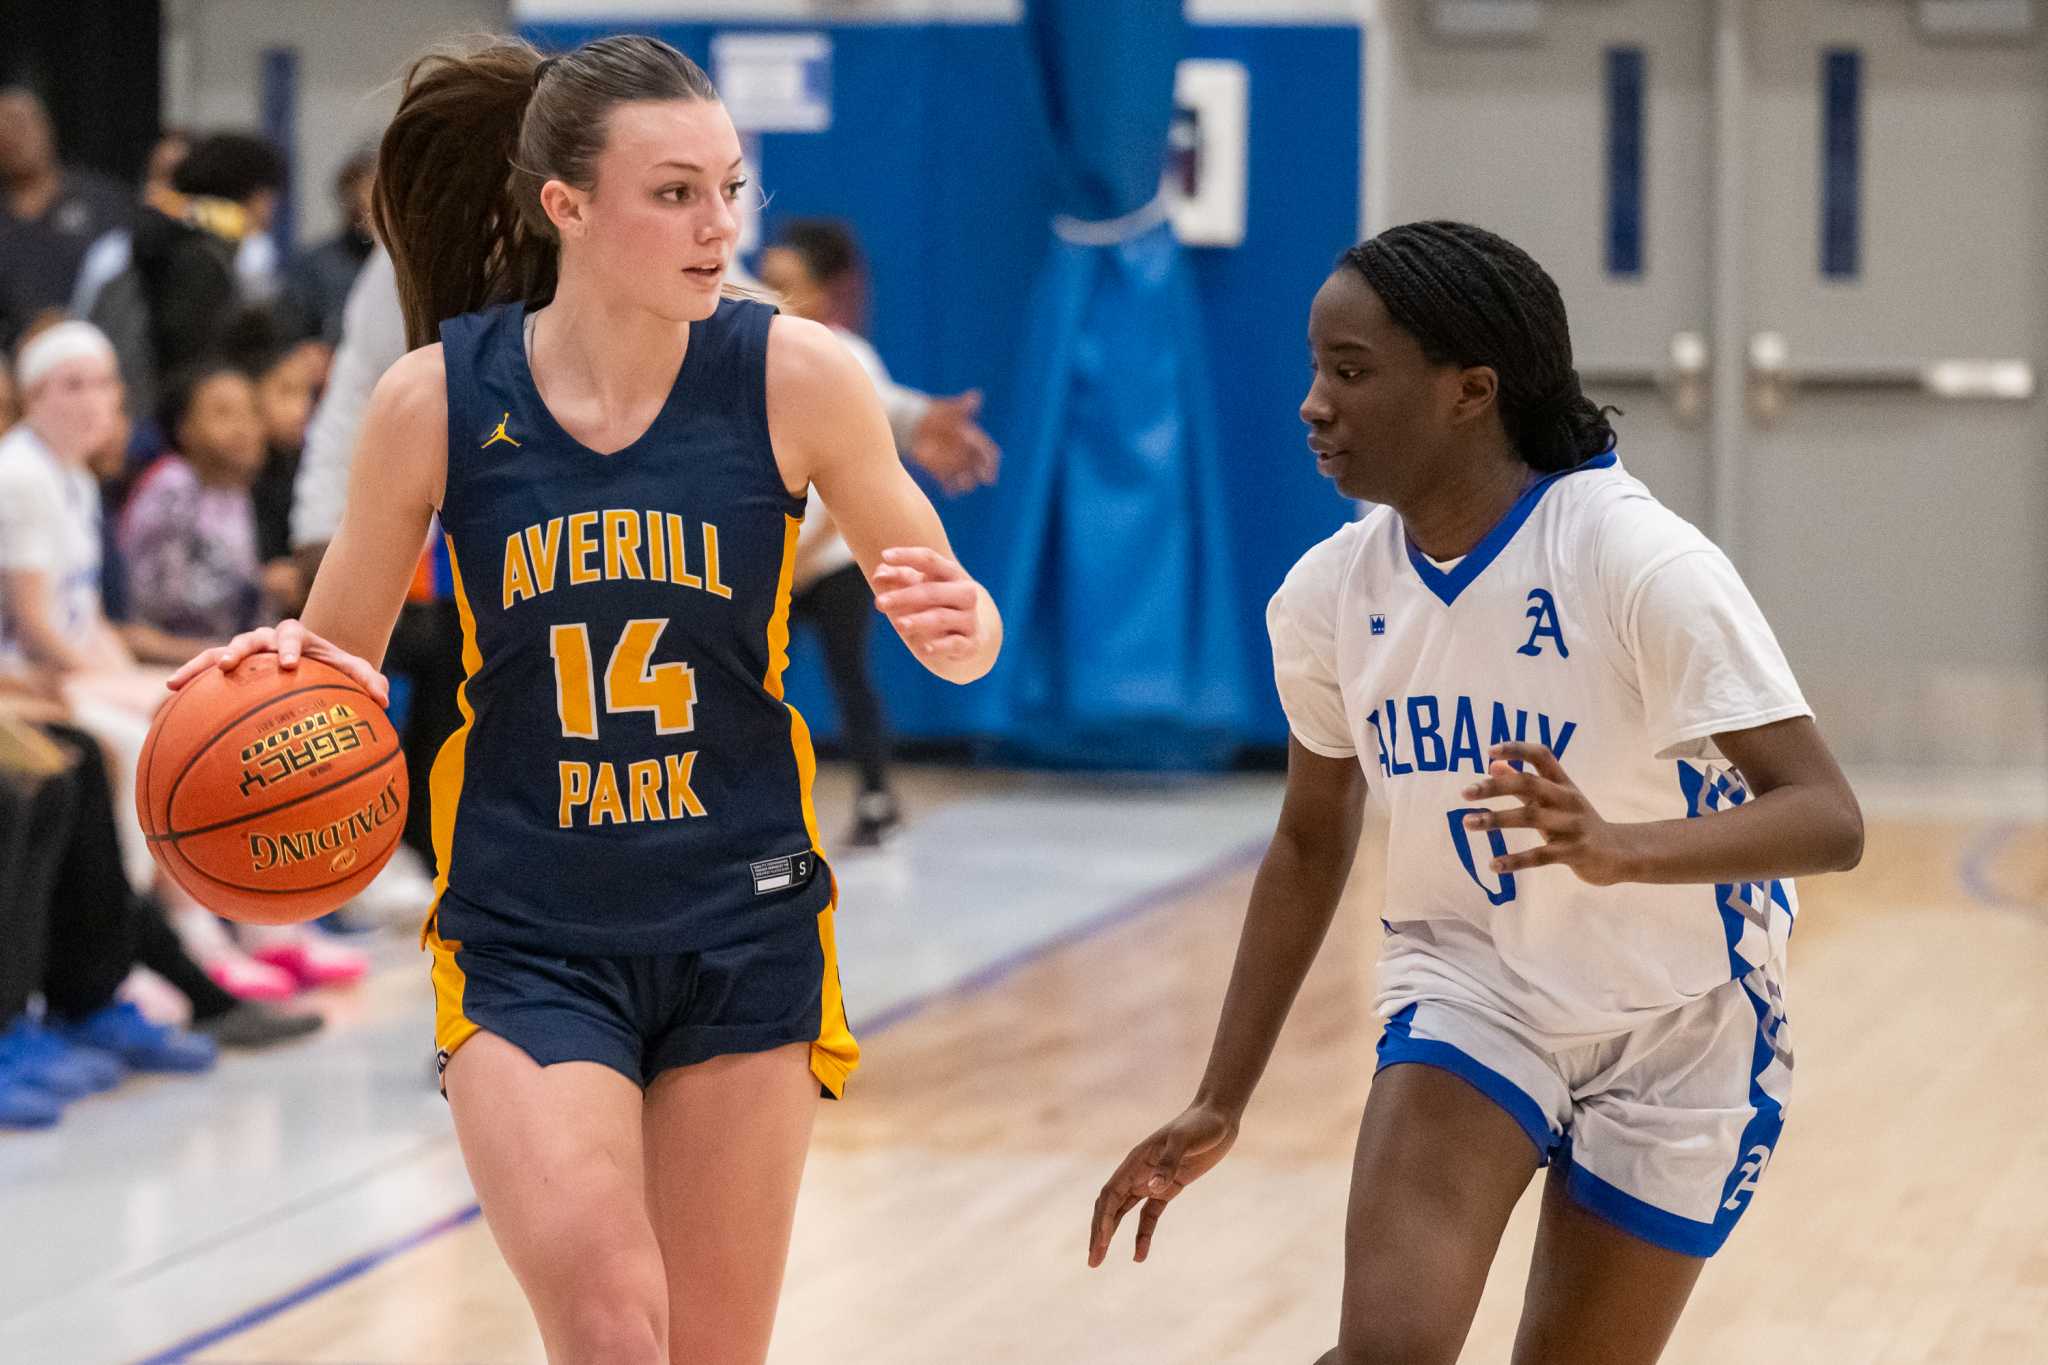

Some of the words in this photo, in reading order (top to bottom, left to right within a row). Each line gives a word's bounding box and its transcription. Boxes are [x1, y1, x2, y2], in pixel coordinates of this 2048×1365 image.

[503, 509, 732, 610] AVERILL
[1516, 588, 1569, 659] A
[550, 618, 698, 740] 14
[239, 720, 378, 797] LEGACY
[558, 750, 708, 828] PARK
[249, 774, 401, 872] SPALDING
[799, 861, 806, 876] S
